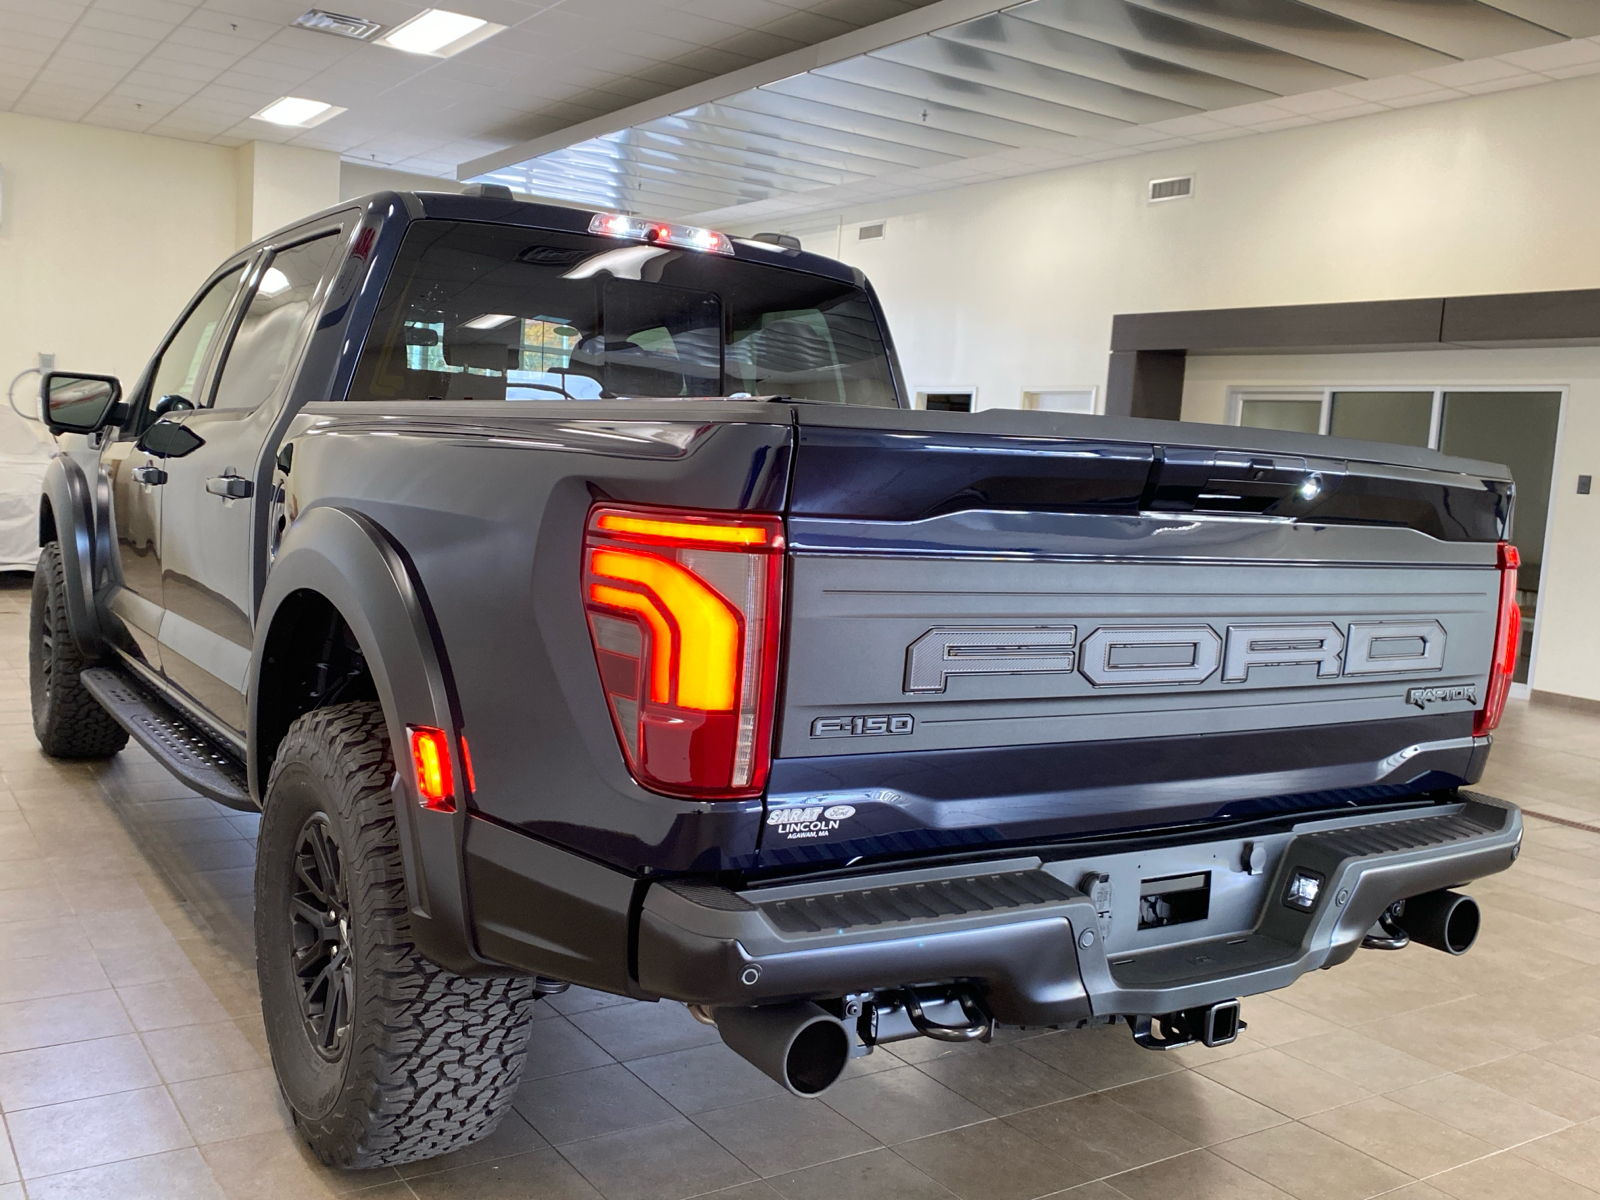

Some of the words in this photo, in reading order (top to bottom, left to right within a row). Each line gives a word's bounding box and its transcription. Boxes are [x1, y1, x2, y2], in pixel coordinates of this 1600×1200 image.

[903, 619, 1448, 693] FORD
[1406, 684, 1477, 709] RAPTOR
[811, 714, 914, 738] F-150
[767, 806, 824, 825] SARAT
[828, 807, 851, 818] Ford
[778, 820, 840, 834] LINCOLN
[787, 831, 818, 840] AGAWAM,
